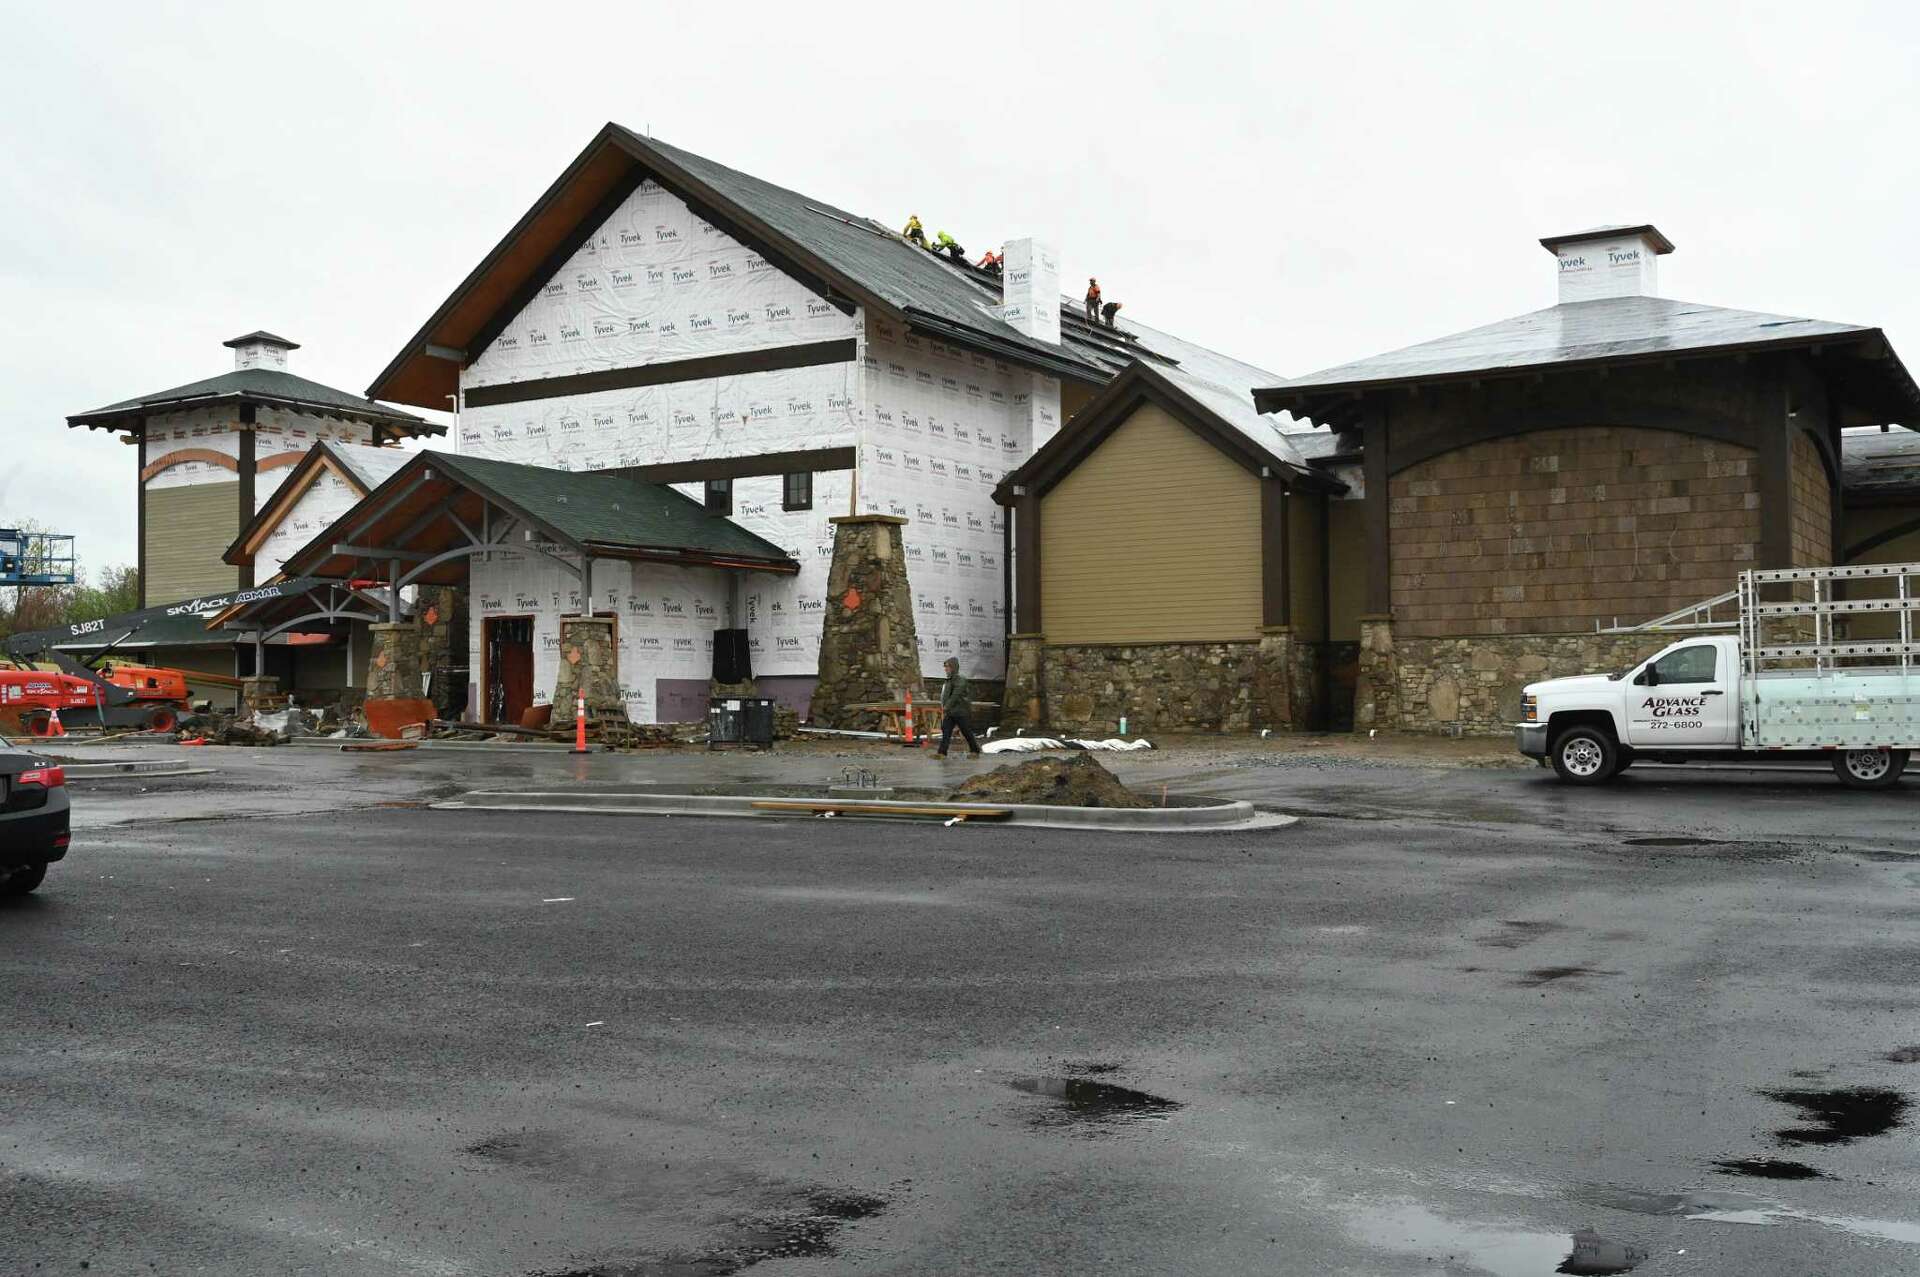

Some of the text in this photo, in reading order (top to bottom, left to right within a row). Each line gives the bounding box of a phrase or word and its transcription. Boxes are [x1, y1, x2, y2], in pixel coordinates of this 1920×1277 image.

[640, 182, 660, 192] Tyve
[620, 234, 642, 244] Tyvek
[656, 230, 677, 240] Tyvek
[1608, 250, 1640, 264] Tyvek
[1559, 256, 1585, 270] yvek
[710, 264, 732, 275] Tyvek
[612, 274, 632, 284] Tyvek
[647, 270, 664, 280] Tyve
[672, 270, 695, 281] Tyvek
[1010, 272, 1027, 282] Tyve
[578, 278, 598, 288] Tyvek
[766, 306, 790, 318] Tyvek
[807, 303, 830, 314] Tyvek
[728, 312, 750, 323] Tyvek
[1004, 308, 1020, 320] yvek
[629, 320, 650, 330] Tyvek
[690, 318, 712, 328] Tyvek
[560, 329, 580, 338] Tyvek
[594, 324, 614, 335] Tyvek
[498, 336, 518, 348] Tyvek
[750, 405, 772, 416] Tyvek
[788, 402, 812, 412] Tyvek
[628, 412, 649, 422] Tyvek
[674, 414, 696, 424] Tyvek
[876, 409, 892, 420] Tyvek
[560, 421, 580, 430] Tyvek
[594, 416, 614, 426] Tyvek
[902, 416, 918, 427] Tyvek
[526, 425, 546, 436] Tyvek
[929, 421, 944, 432] Tyvek
[462, 432, 480, 441] Tyvek
[494, 428, 512, 438] Tyvek
[954, 428, 968, 438] Tyvek
[977, 433, 992, 444] Tyvek
[876, 449, 892, 460] Tyvek
[904, 454, 919, 466] Tyvek
[930, 460, 945, 470] Tyvek
[955, 464, 969, 475] Tyvek
[979, 470, 992, 480] Tyvek
[741, 504, 764, 515] Tyvek
[890, 504, 906, 515] Tyvek
[918, 509, 932, 520] Tyvek
[943, 513, 958, 524] Tyvek
[968, 517, 982, 527] Tyvek
[817, 546, 833, 556] Tyv
[906, 546, 921, 556] Tyvek
[932, 550, 947, 560] Tyvek
[957, 552, 971, 562] Tyvek
[981, 556, 994, 566] Tyvek
[167, 586, 280, 616] SKYJACK ADMAR
[480, 599, 502, 609] Tyvek
[516, 598, 538, 608] Tyvek
[798, 600, 822, 610] Tyvek
[919, 600, 935, 610] Tyvek
[944, 601, 960, 611] Tyvek
[630, 601, 650, 612] Tyvek
[663, 602, 682, 613] Tyvek
[696, 604, 714, 614] Tyvek
[970, 604, 983, 612] Tyvek
[71, 619, 105, 636] SJ82T
[543, 638, 560, 648] Tyve
[776, 636, 800, 647] Tyvek
[934, 640, 949, 648] Tyvek
[620, 690, 642, 700] Tyvek
[1641, 697, 1707, 708] ADVANCE
[1652, 706, 1700, 717] GLASS
[1650, 721, 1703, 729] 272-6800
